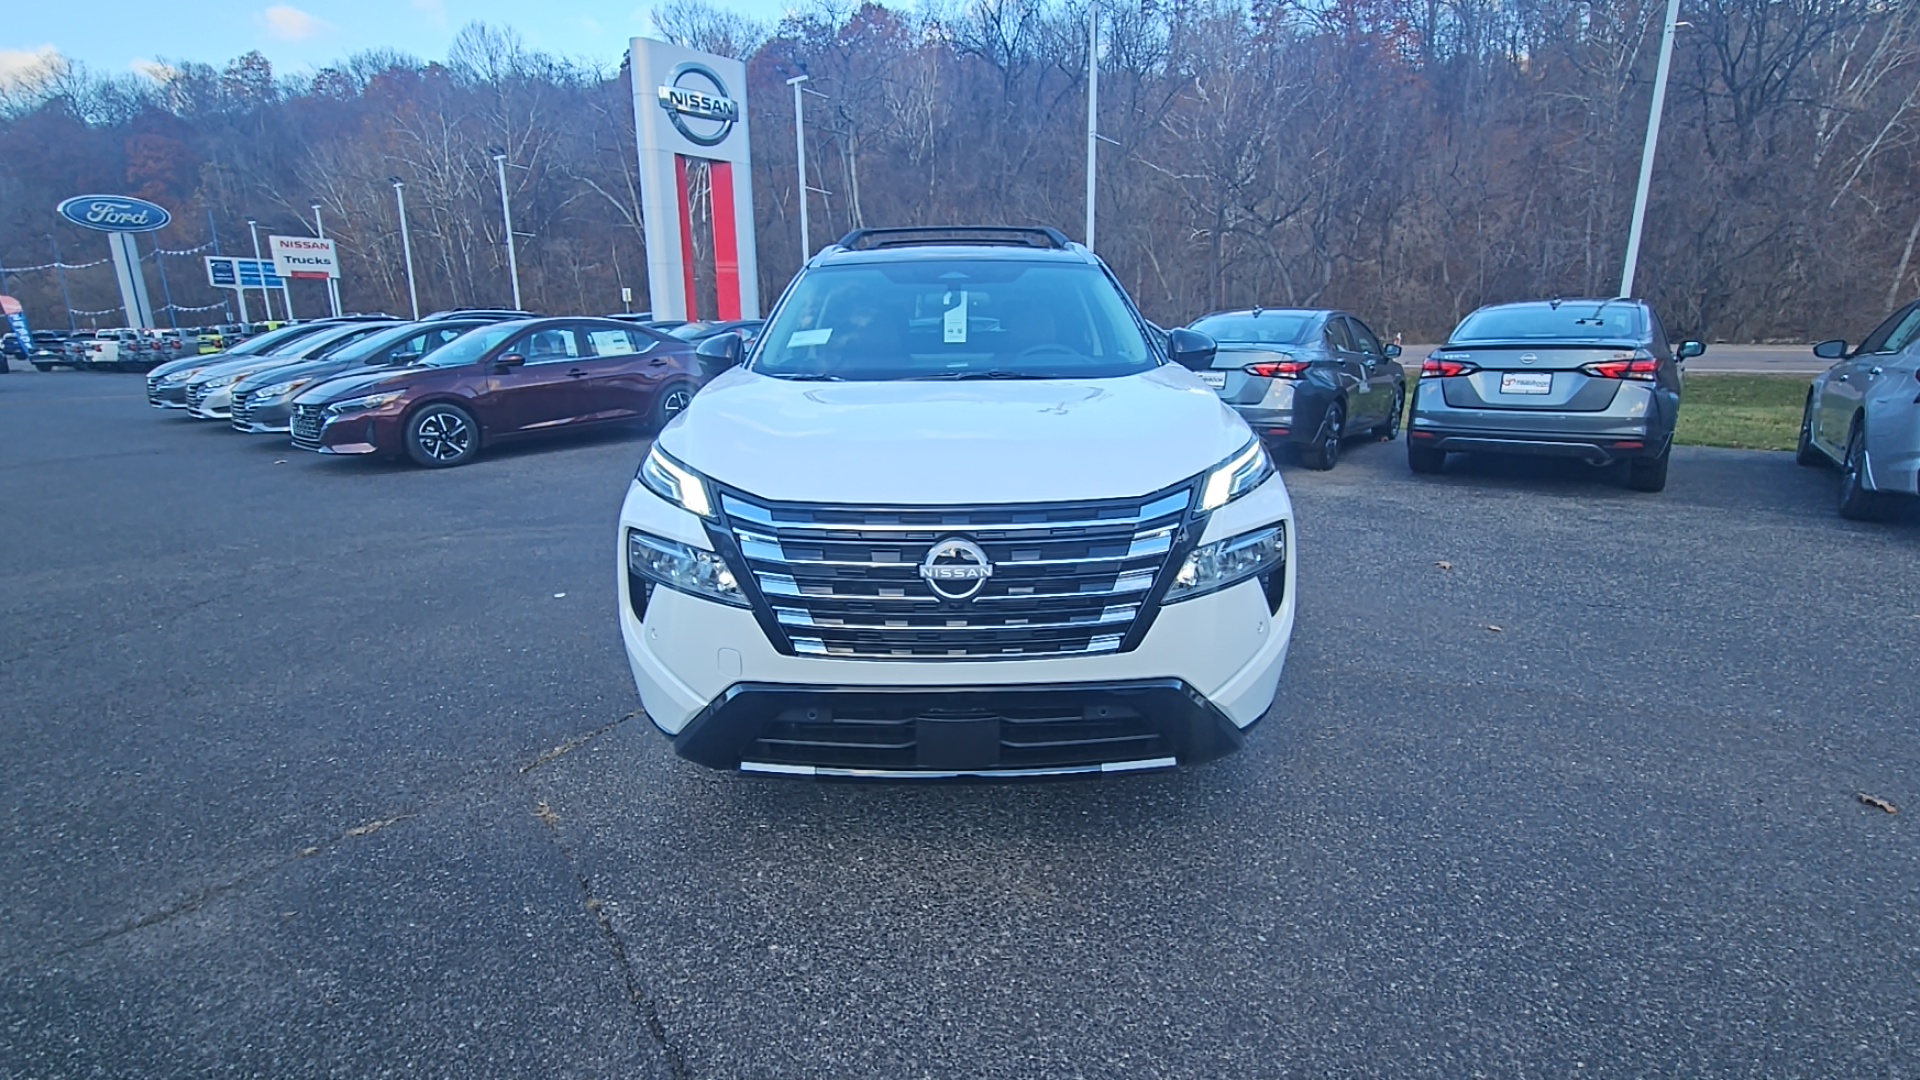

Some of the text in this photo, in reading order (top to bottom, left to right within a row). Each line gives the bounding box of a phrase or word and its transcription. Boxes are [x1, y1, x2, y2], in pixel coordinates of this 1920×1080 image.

[669, 91, 733, 115] NISSAN
[86, 201, 149, 225] Ford
[280, 240, 330, 250] NISSAN
[284, 255, 331, 265] Trucks
[921, 568, 992, 578] NISSAN
